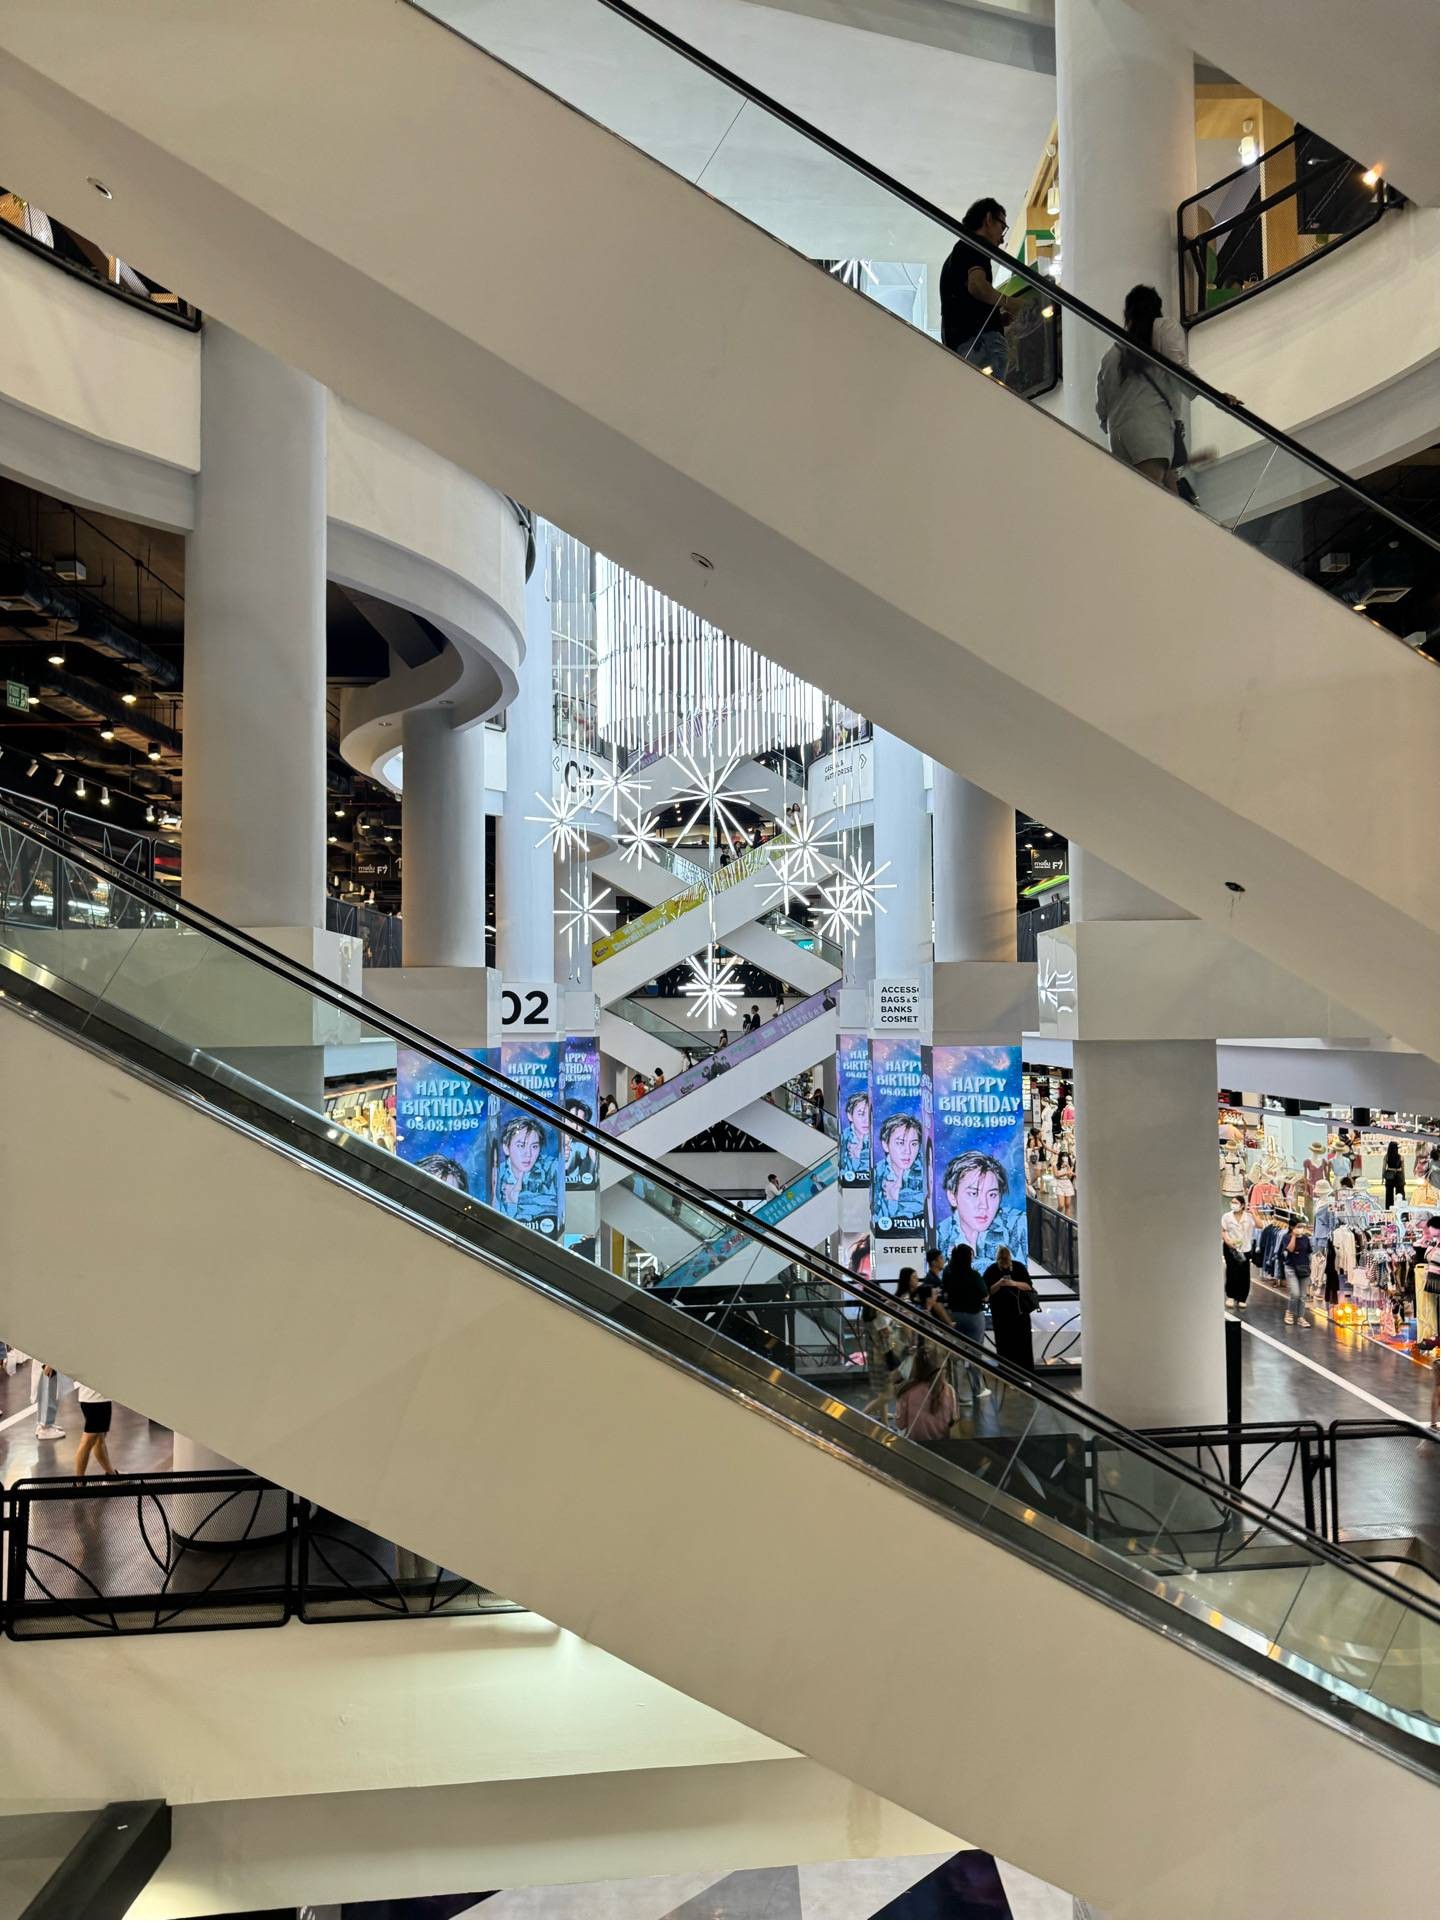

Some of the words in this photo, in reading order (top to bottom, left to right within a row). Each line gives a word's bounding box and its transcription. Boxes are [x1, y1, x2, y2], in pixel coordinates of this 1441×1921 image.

[502, 990, 549, 1025] 02
[880, 1015, 919, 1023] COSMET
[508, 1062, 548, 1075] HAPPY
[415, 1079, 471, 1096] HAPPY
[952, 1076, 1007, 1093] HAPPY
[402, 1098, 484, 1117] BIRTHDAY
[938, 1095, 1020, 1113] BIRTHDAY
[406, 1117, 479, 1132] 08.03.1998
[944, 1115, 1016, 1129] 08.03.1998
[883, 1246, 919, 1254] STREET
